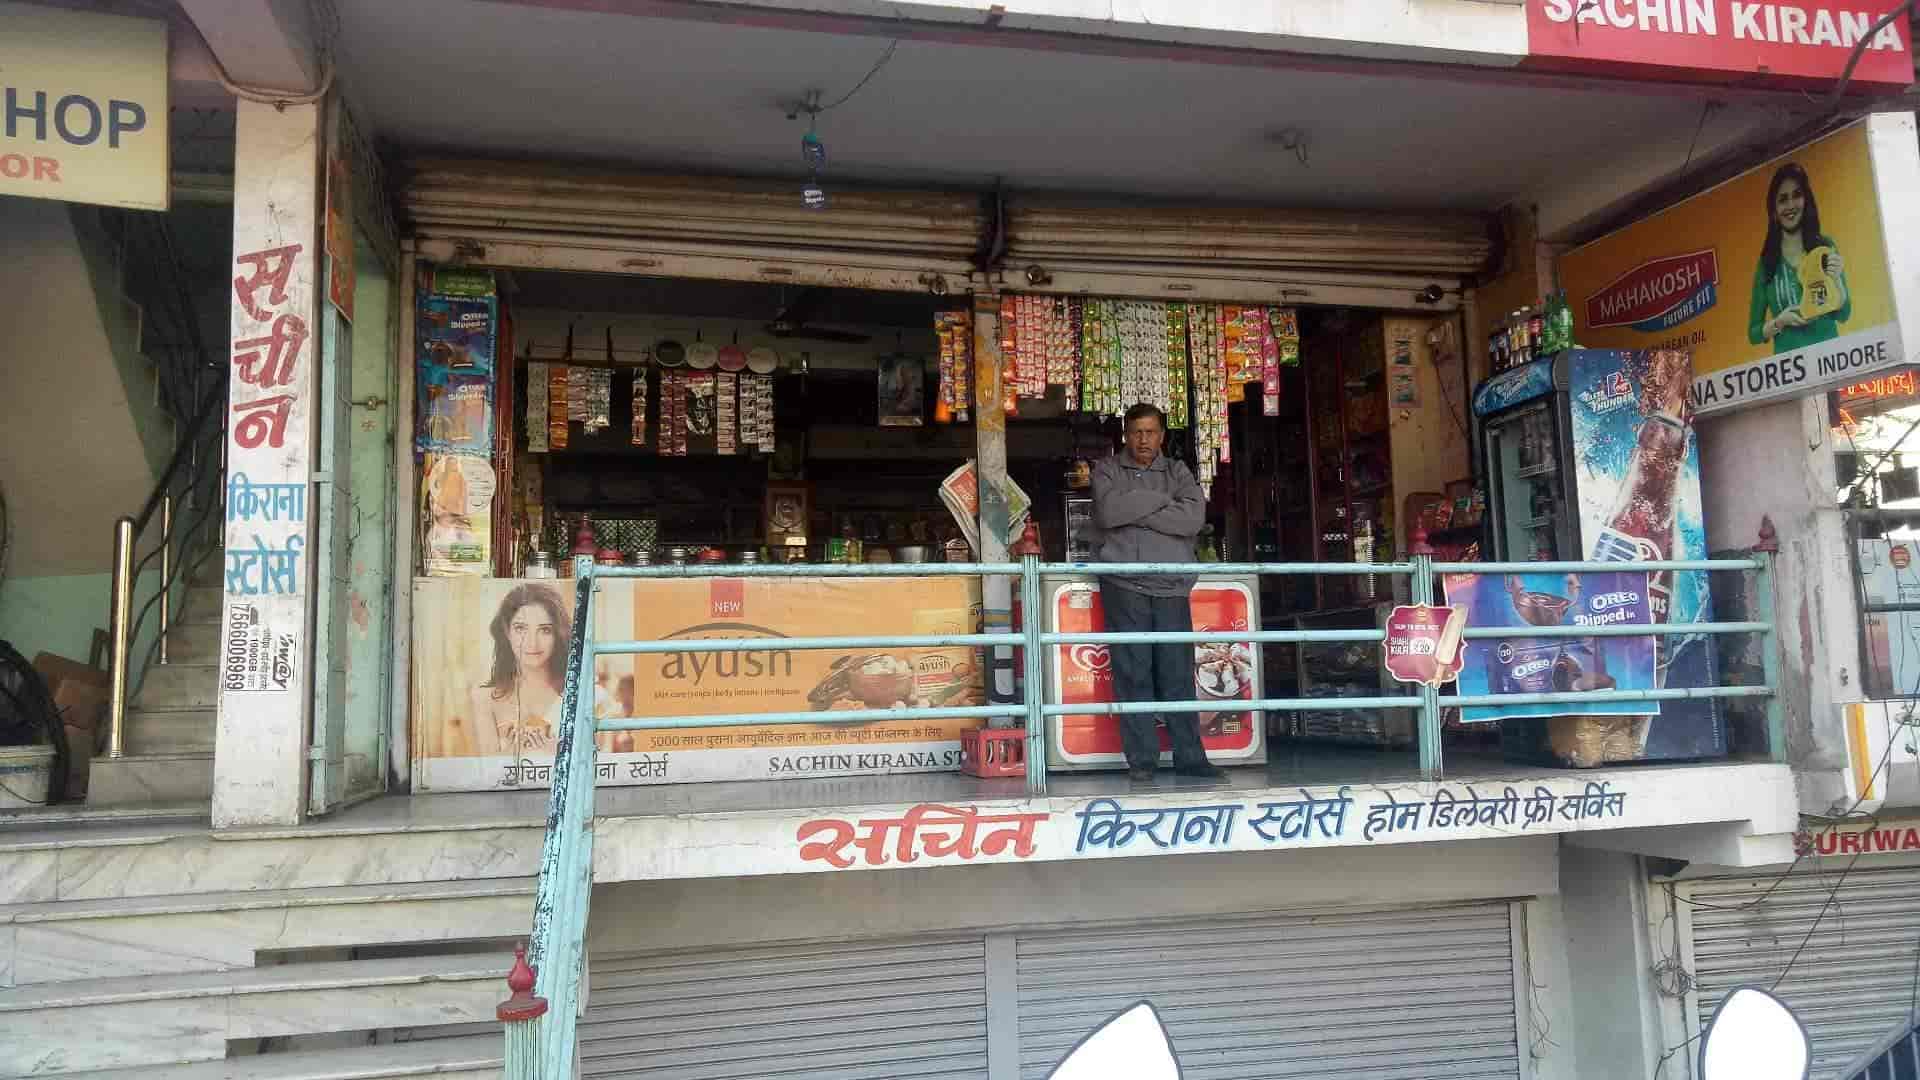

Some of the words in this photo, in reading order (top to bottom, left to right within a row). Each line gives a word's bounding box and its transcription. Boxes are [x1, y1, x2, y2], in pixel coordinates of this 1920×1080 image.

[1545, 0, 1718, 36] SACHIN
[1731, 2, 1905, 51] KIRANA
[6, 87, 146, 148] HOP
[0, 153, 61, 183] OR
[1600, 262, 1701, 320] MAHAKOSH
[1663, 300, 1695, 328] FUTURE
[1697, 286, 1711, 311] FIT
[1723, 354, 1806, 400] STORES
[1818, 341, 1887, 377] INDORE
[228, 472, 306, 522] किराना
[226, 533, 305, 594] स्टोर्स
[714, 601, 741, 613] NEW
[1574, 607, 1625, 626] Dipped
[1591, 592, 1640, 612] OREO
[227, 604, 250, 689] 7566006969
[249, 638, 258, 672] 1000GB
[1513, 659, 1550, 678] OREO
[650, 735, 680, 748] 5000
[627, 753, 669, 778] स्टोर्स
[769, 752, 851, 773] SACHIN
[857, 751, 939, 769] KIRANA
[797, 803, 1049, 867] सचिन
[1075, 799, 1242, 853] किराना
[1248, 786, 1353, 841] स्टोर्स
[1363, 791, 1425, 841] होम
[1427, 786, 1519, 828] डिलेवरी
[1557, 781, 1627, 821] सर्विस
